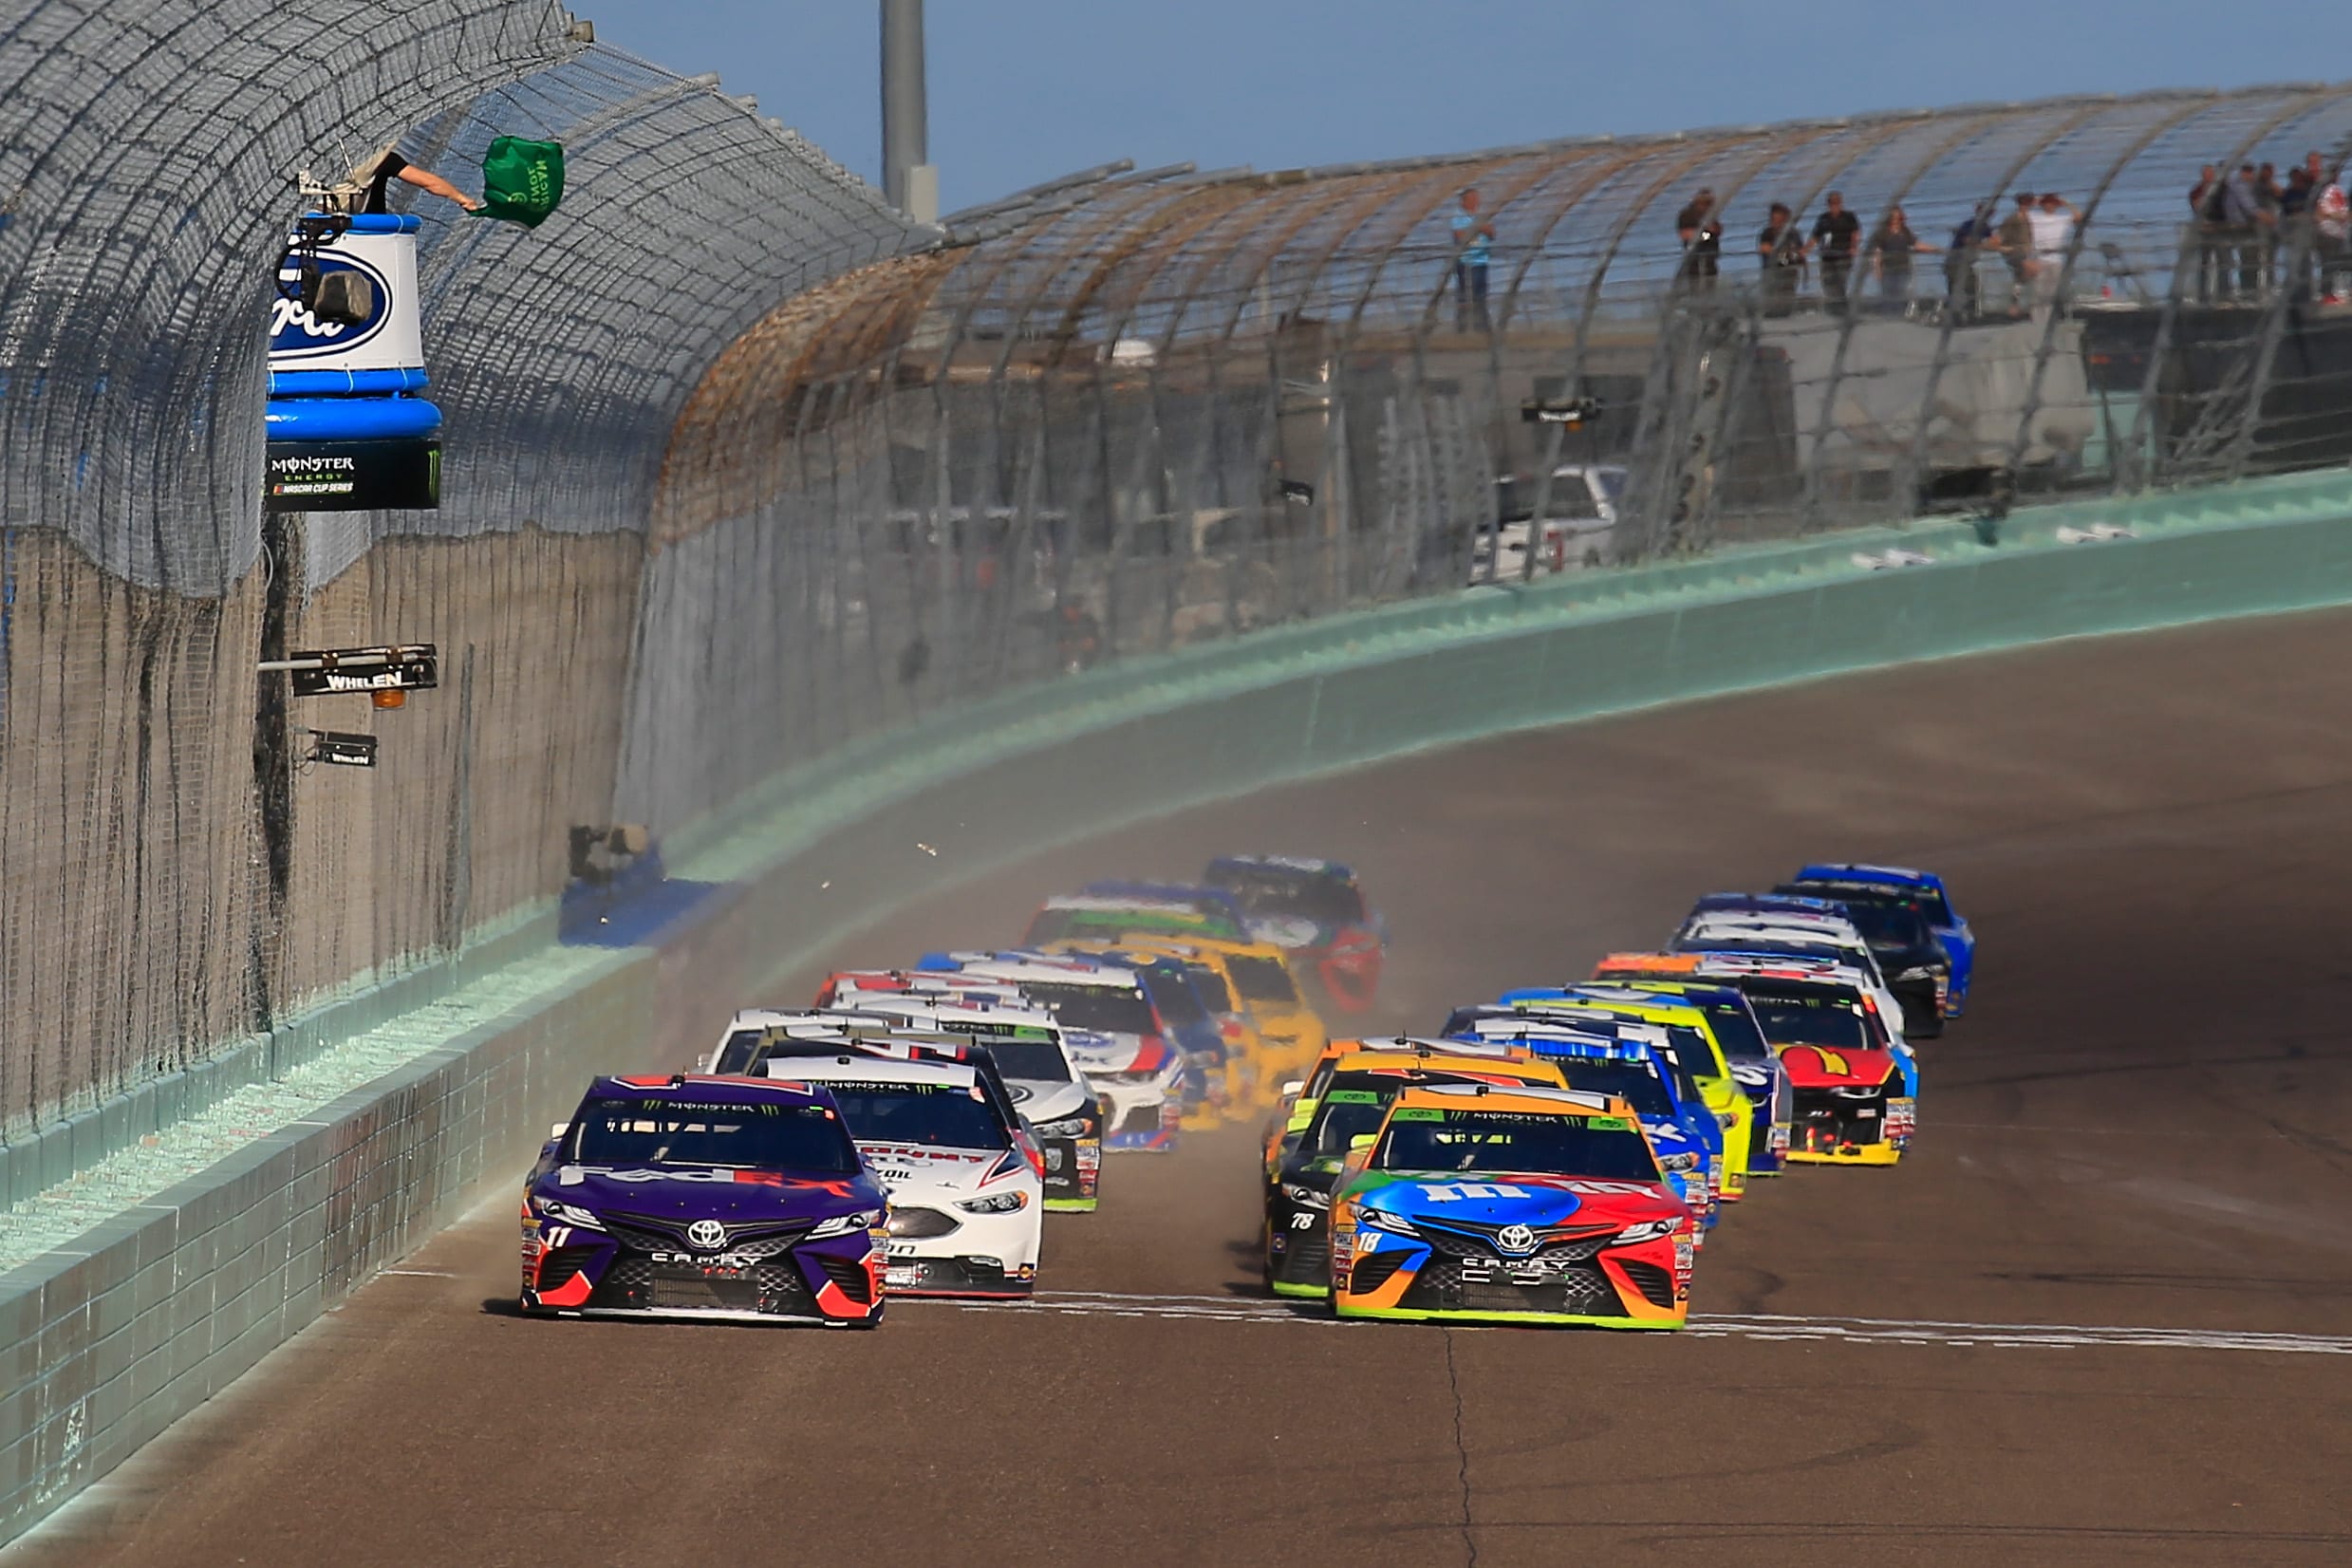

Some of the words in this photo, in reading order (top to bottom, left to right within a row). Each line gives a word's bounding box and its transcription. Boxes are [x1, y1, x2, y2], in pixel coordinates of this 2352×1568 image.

[271, 456, 354, 474] MONSTER
[326, 671, 402, 690] WHELEN
[829, 1081, 910, 1092] MONSTER
[667, 1101, 755, 1113] MONSTER
[1473, 1112, 1558, 1124] MONSTER
[1290, 1212, 1316, 1230] 78
[546, 1225, 573, 1249] 11
[1356, 1231, 1383, 1253] 18
